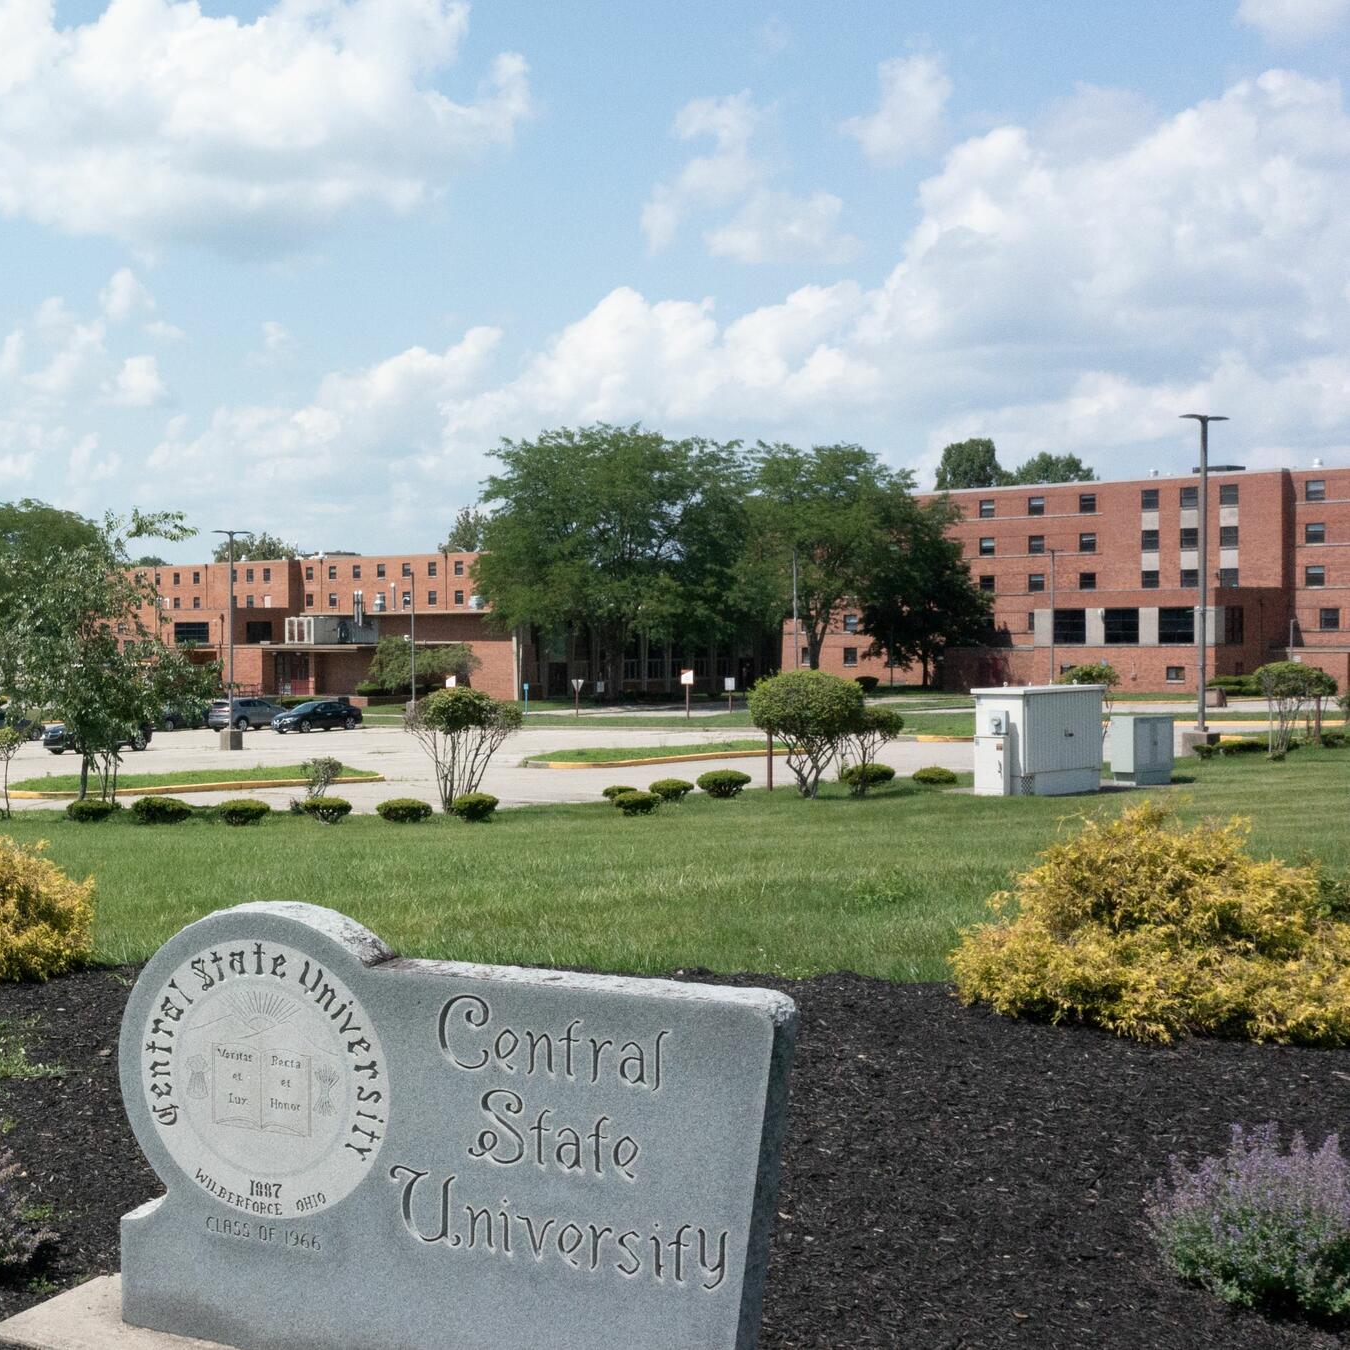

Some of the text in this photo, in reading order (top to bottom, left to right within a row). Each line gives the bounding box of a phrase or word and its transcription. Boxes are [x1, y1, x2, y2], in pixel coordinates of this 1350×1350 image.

[145, 943, 385, 1161] Central State University
[217, 1048, 253, 1062] Veritas
[438, 994, 669, 1092] Central
[271, 1055, 301, 1069] Recta
[232, 1073, 243, 1081] et
[281, 1079, 291, 1087] et
[270, 1098, 301, 1111] Honor
[468, 1089, 639, 1179] State
[195, 1168, 326, 1215] WILBERFORCE OHIO
[250, 1180, 282, 1199] 1887
[206, 1216, 321, 1251] CLASS OF 1966
[389, 1164, 729, 1290] University
